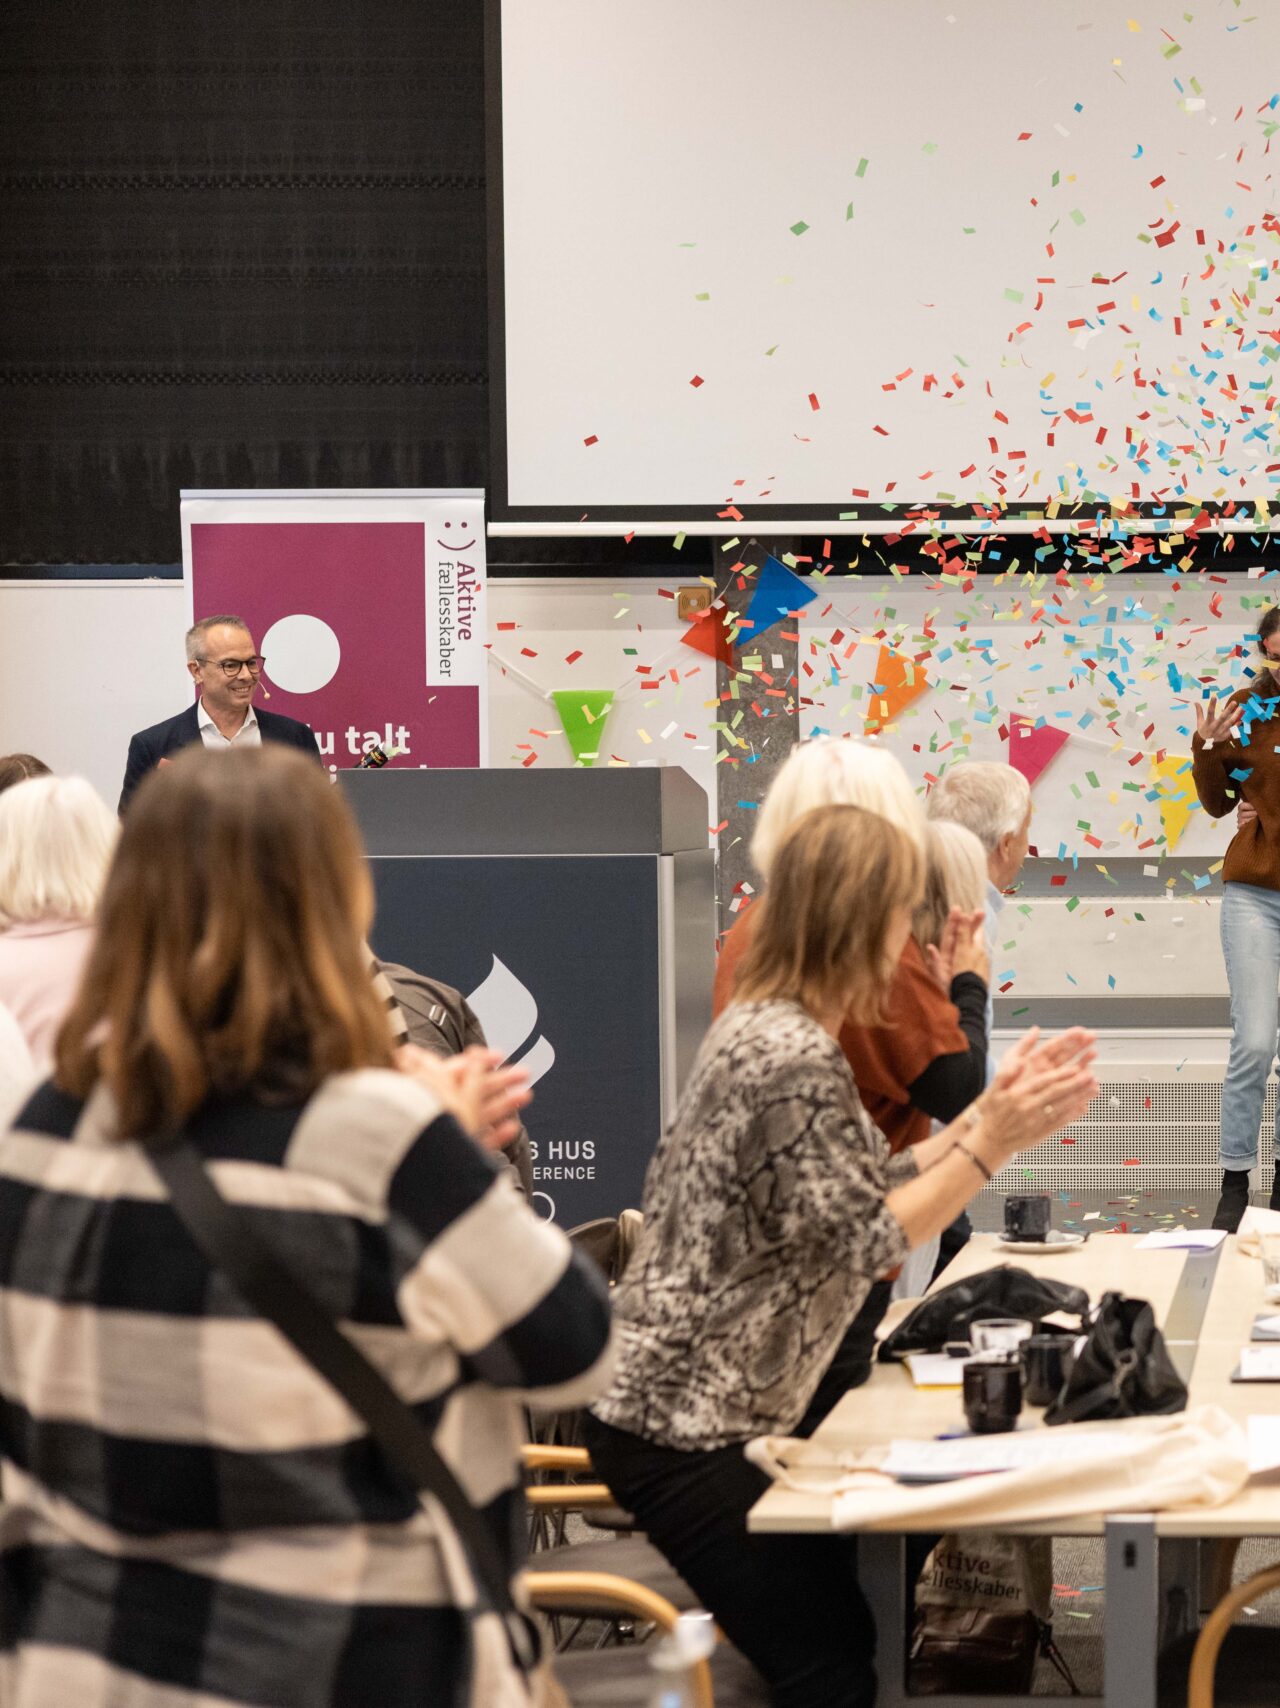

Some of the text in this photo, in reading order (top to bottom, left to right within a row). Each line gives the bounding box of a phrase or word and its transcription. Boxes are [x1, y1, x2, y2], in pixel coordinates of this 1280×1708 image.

[457, 561, 476, 640] Aktive
[438, 562, 455, 677] fællesskaber
[345, 723, 411, 755] talt
[548, 1140, 596, 1160] HUS
[532, 1166, 596, 1180] ERENCE
[933, 1549, 991, 1575] ktive
